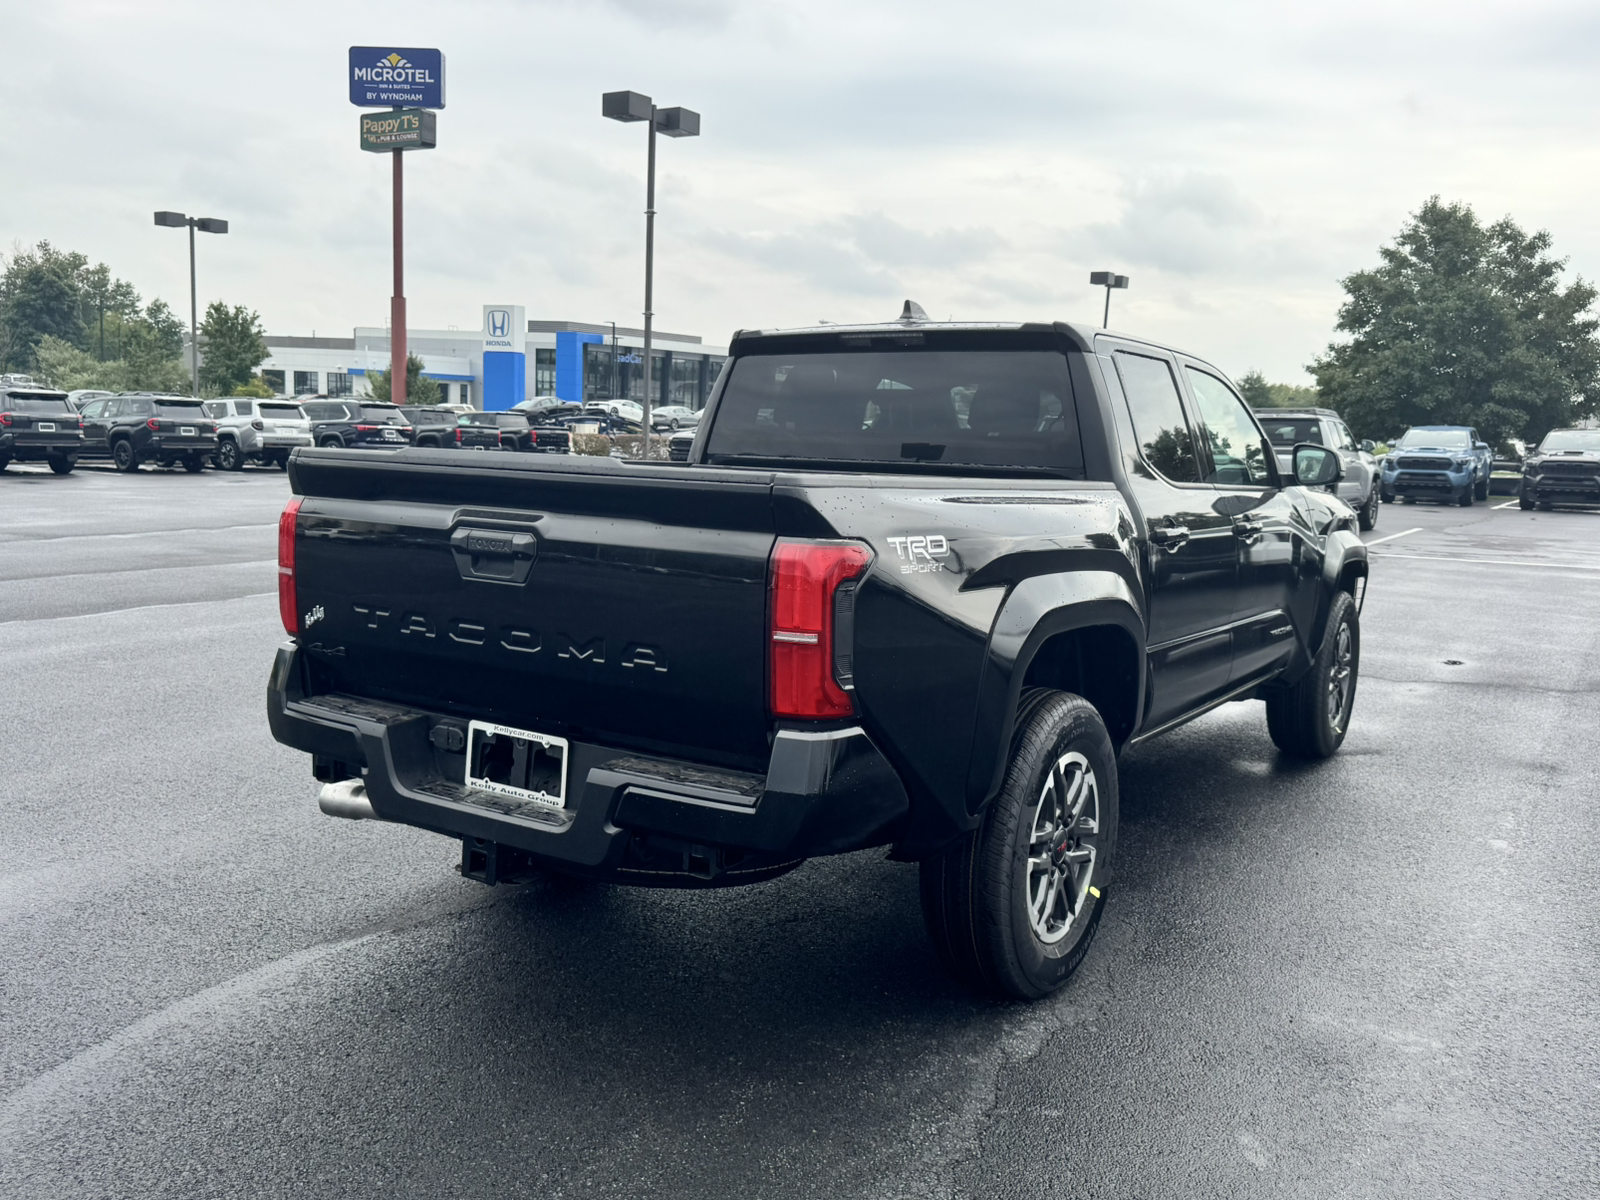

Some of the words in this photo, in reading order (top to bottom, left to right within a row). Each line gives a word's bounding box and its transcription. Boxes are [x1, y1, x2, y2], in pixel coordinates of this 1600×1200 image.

[354, 67, 434, 83] MICROTEL
[366, 92, 377, 100] BY
[380, 93, 422, 101] WYNDHAM
[363, 119, 400, 133] Pappy
[402, 115, 419, 129] T's
[396, 133, 418, 141] LOUNGE
[470, 539, 510, 552] TOYOTA
[886, 535, 947, 561] TRD
[900, 563, 945, 575] SPORT
[353, 605, 668, 672] TACOMA
[494, 725, 544, 741] Kellycar.com
[470, 780, 497, 792] Kelly
[500, 787, 525, 798] Auto
[527, 793, 560, 807] Group
